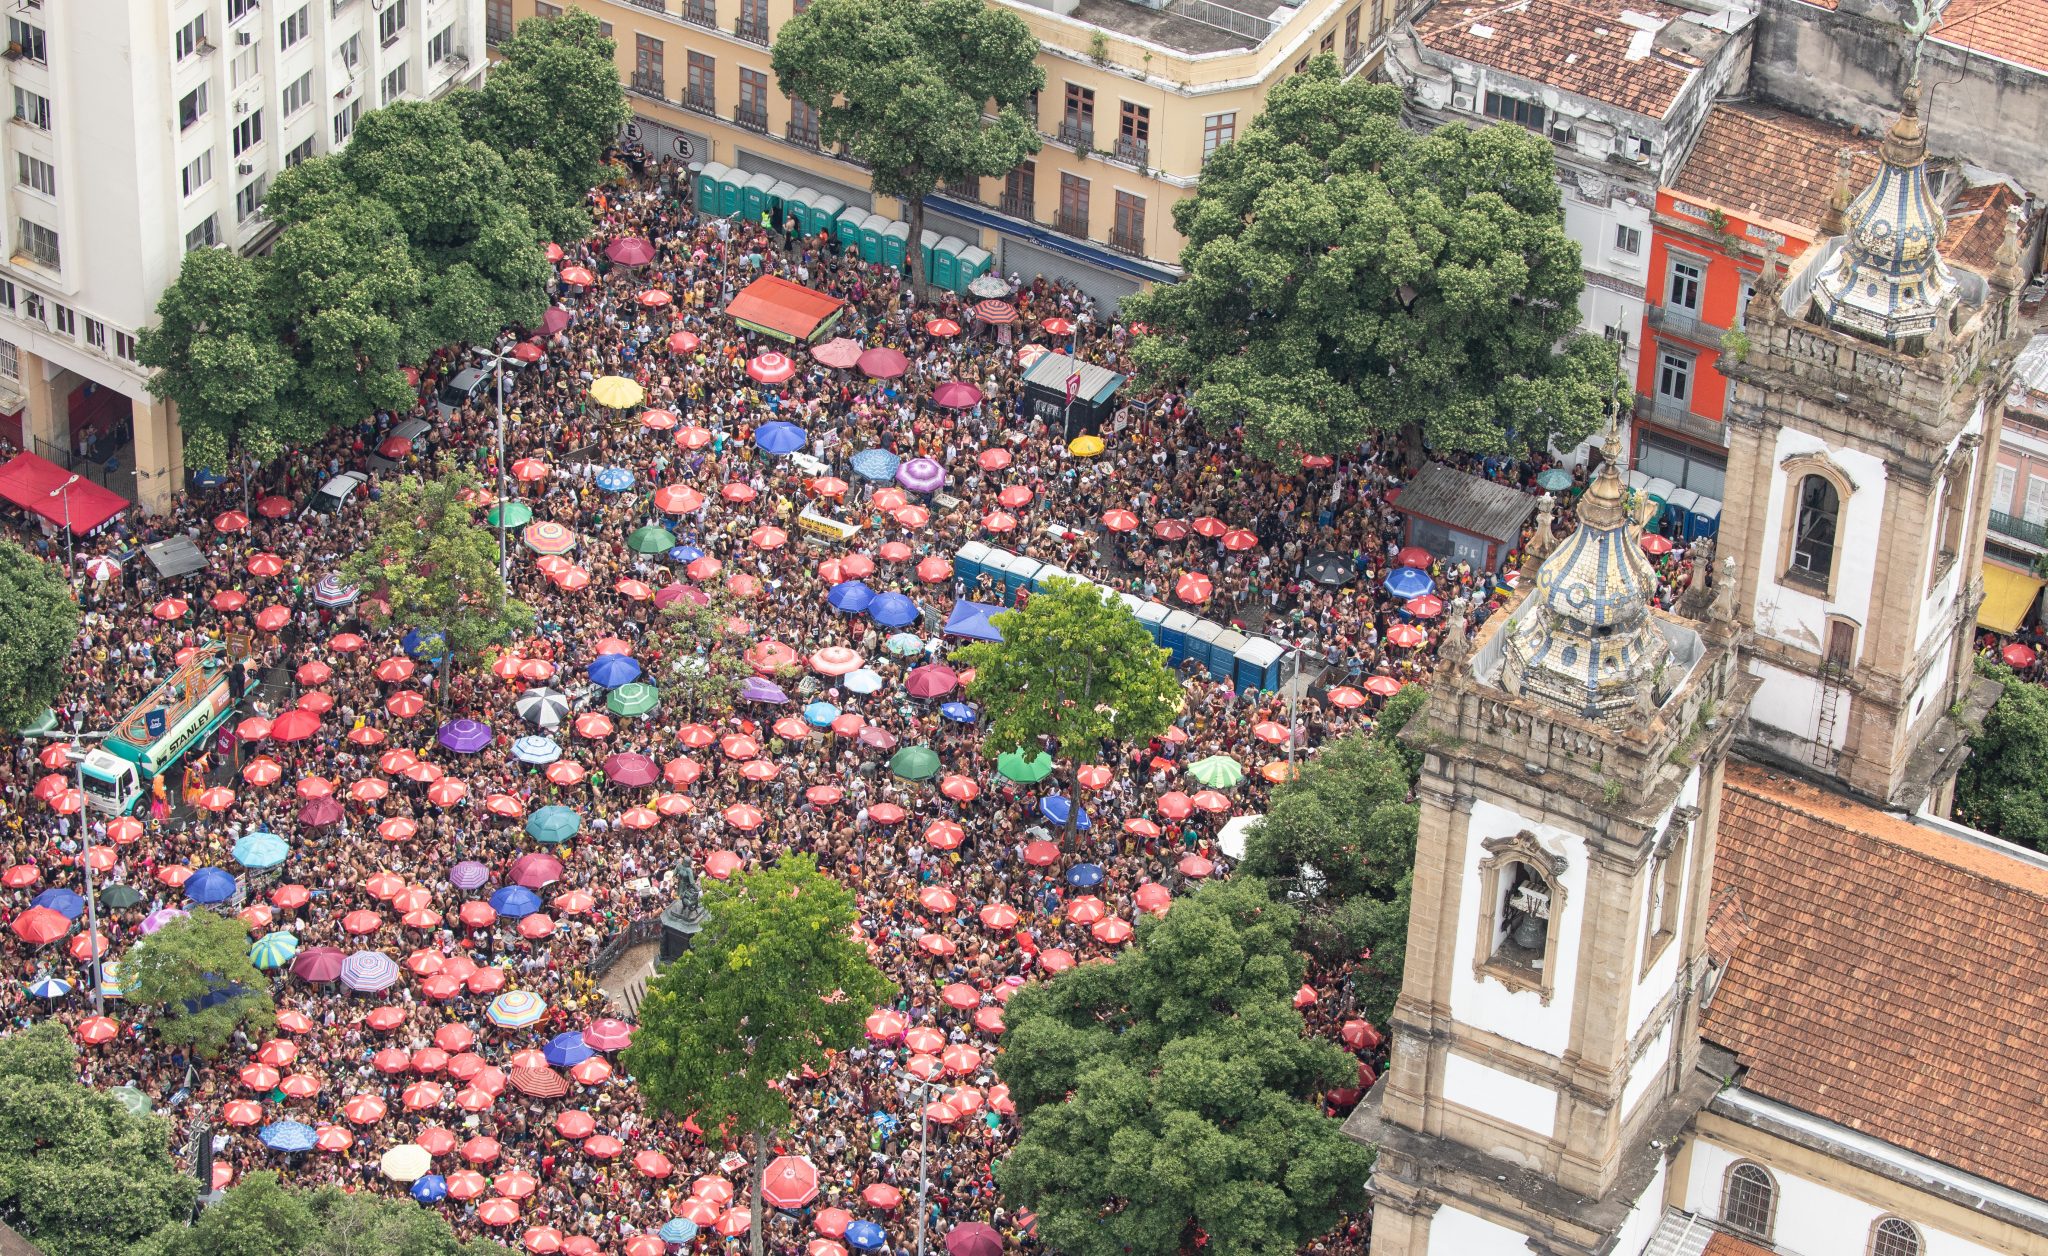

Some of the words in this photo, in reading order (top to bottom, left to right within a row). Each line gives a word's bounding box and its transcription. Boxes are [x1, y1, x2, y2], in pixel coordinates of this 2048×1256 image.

[627, 124, 637, 138] E
[679, 140, 688, 155] E
[169, 710, 210, 755] STANLEY
